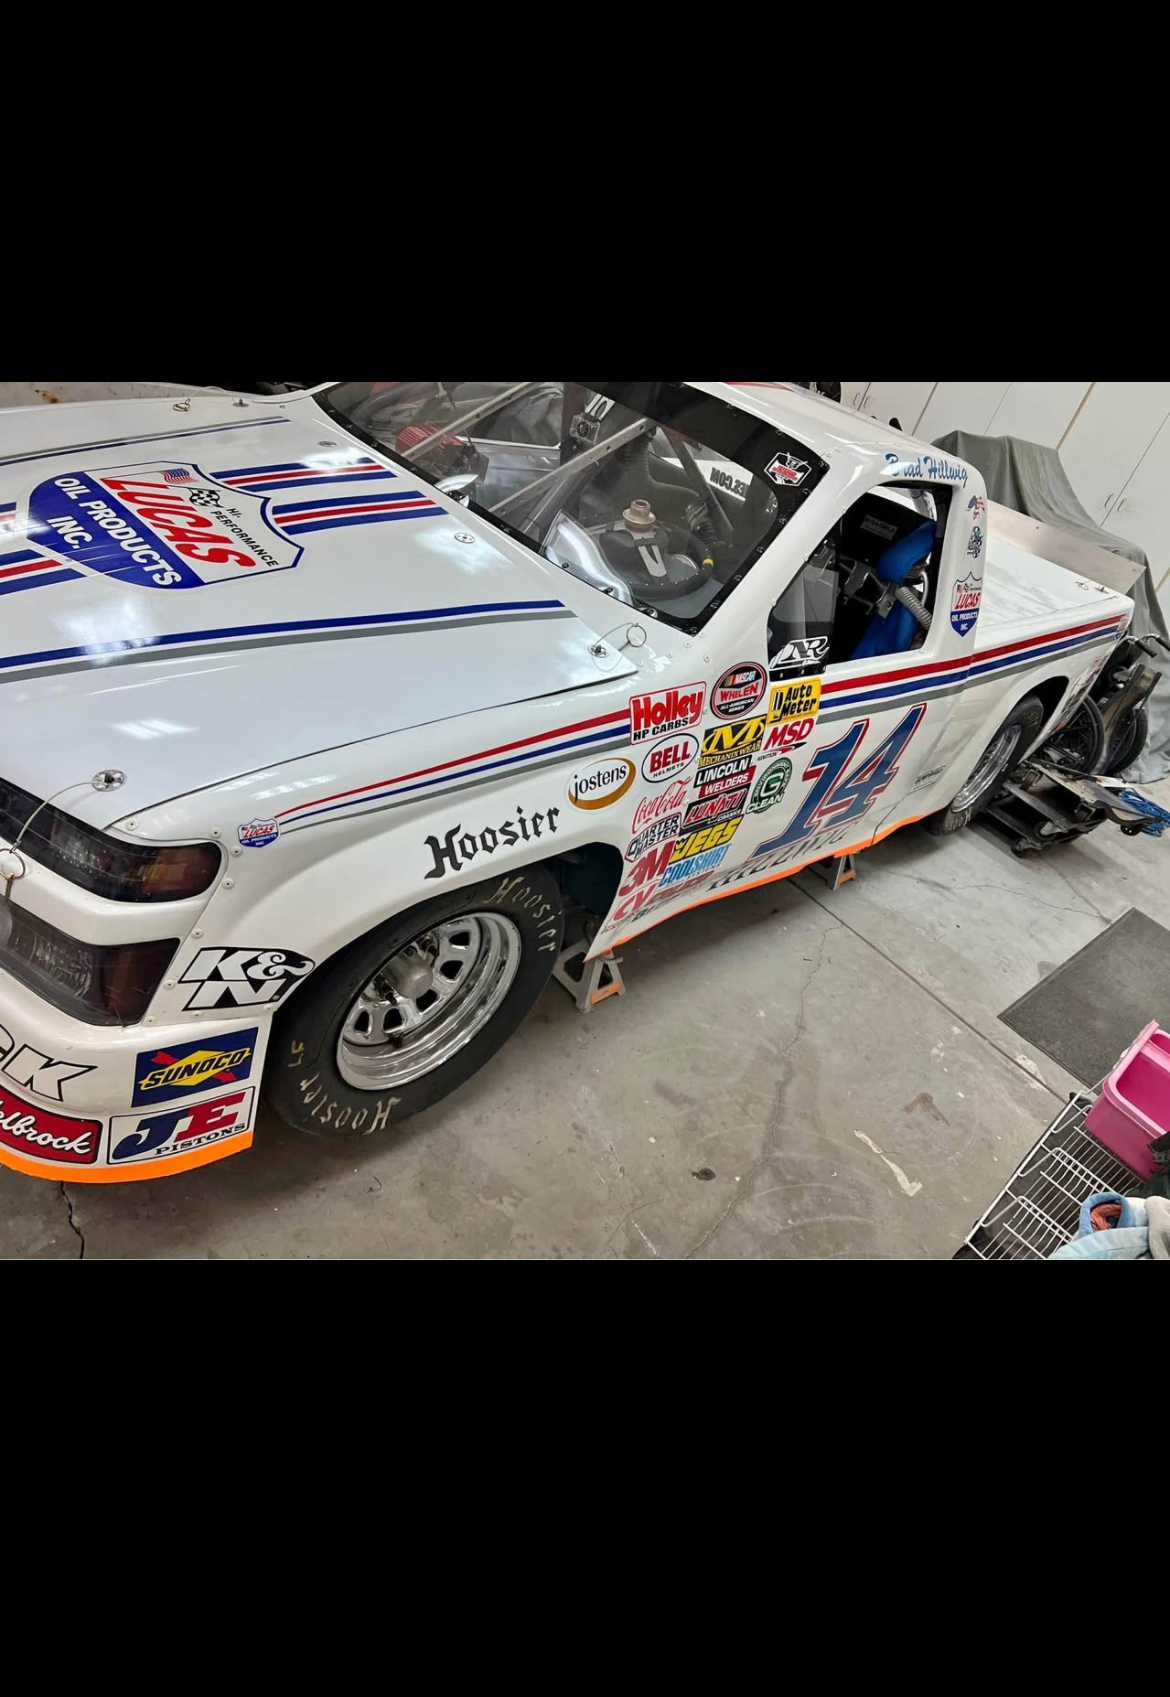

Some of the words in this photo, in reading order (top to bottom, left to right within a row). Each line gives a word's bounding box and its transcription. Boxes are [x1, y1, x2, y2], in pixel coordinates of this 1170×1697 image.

[923, 456, 968, 489] Hillwig
[47, 515, 93, 549] INC.
[54, 477, 89, 500] OIL
[79, 500, 182, 586] PRODUCTS
[100, 477, 256, 567] LUCAS
[210, 511, 279, 567] PERFORMANCE
[955, 592, 981, 610] LUCAS
[720, 682, 758, 702] WHELEN
[735, 670, 757, 681] NASCAR
[720, 698, 755, 710] ALL-AMERICAN
[782, 698, 816, 717] Meter
[784, 684, 812, 702] Auto
[632, 690, 703, 731] Holley
[633, 729, 649, 741] HP
[652, 717, 688, 735] CARBS
[763, 718, 815, 751] MSD
[650, 741, 691, 773] BELL
[653, 762, 685, 778] HELMETS
[698, 751, 738, 767] MECHANIX
[738, 741, 761, 756] WEAR
[573, 765, 627, 804] jostens
[696, 757, 749, 785] LINCOLN
[704, 773, 749, 796] WELDERS
[751, 703, 927, 859] 14
[760, 772, 784, 798] G
[685, 790, 746, 824] LUNATI
[746, 792, 785, 814] CLEAN
[243, 825, 275, 838] LUCAS
[424, 806, 560, 880] Hoosier
[627, 814, 680, 857] QUARTER
[634, 825, 680, 859] MASTER
[671, 815, 744, 863] JEGS
[618, 840, 676, 897] 3M
[482, 877, 562, 951] Hoosier
[181, 949, 316, 1009] K&N
[139, 1047, 251, 1090] SUNOCO
[300, 1072, 401, 1135] Hoosier
[112, 1091, 246, 1160] JE
[154, 1122, 246, 1155] PISTONS
